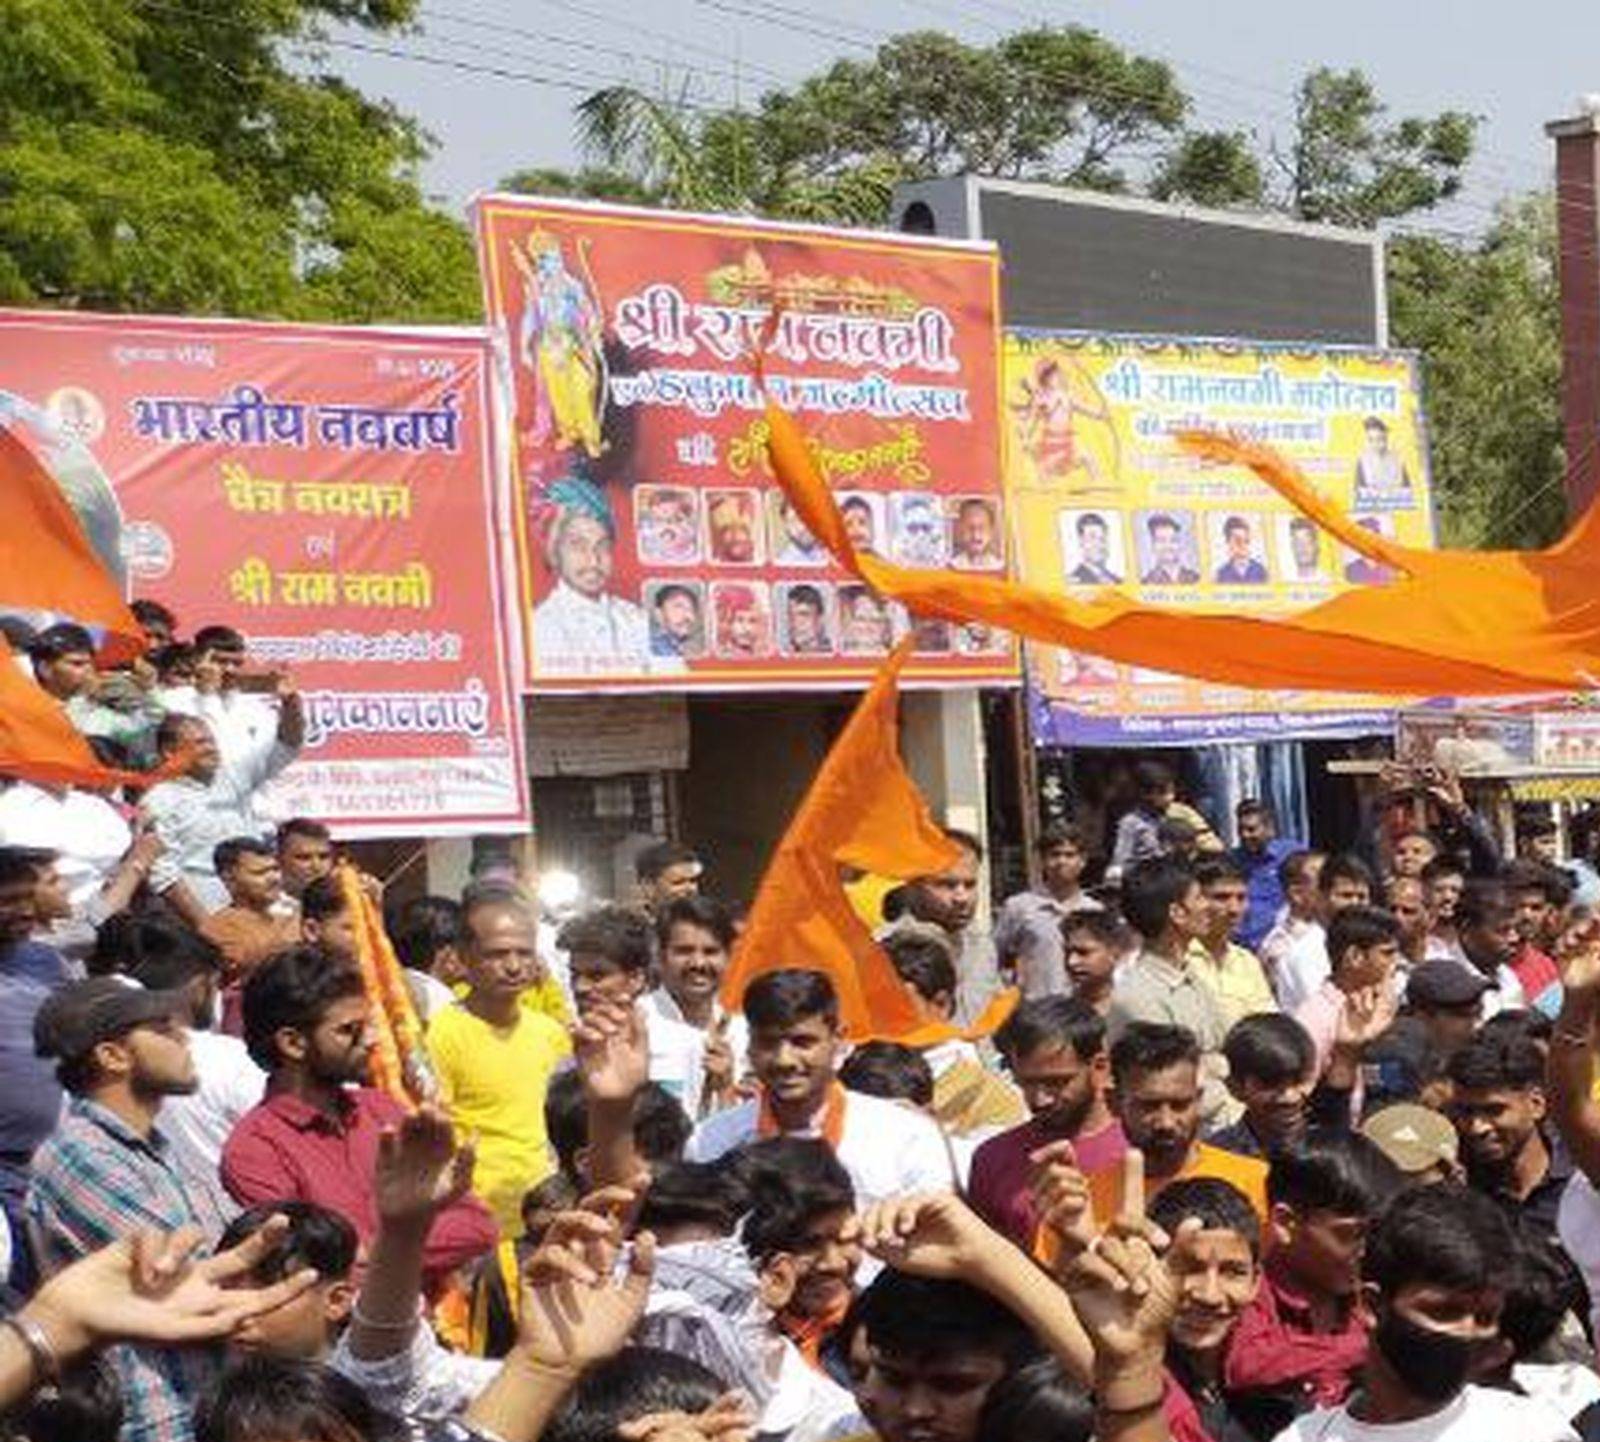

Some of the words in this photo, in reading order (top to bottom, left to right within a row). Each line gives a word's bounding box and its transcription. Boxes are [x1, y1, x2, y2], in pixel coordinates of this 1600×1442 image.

[618, 284, 692, 354] श्री
[809, 308, 962, 372] नवमी
[1105, 361, 1142, 400] श्री
[134, 384, 306, 446] भारतीय
[318, 386, 462, 453] नववर्ष
[221, 460, 284, 515] चैत्र
[294, 480, 413, 520] नवरात्र
[230, 557, 272, 607] श्री
[279, 572, 338, 606] राम
[344, 563, 433, 609] नवमी
